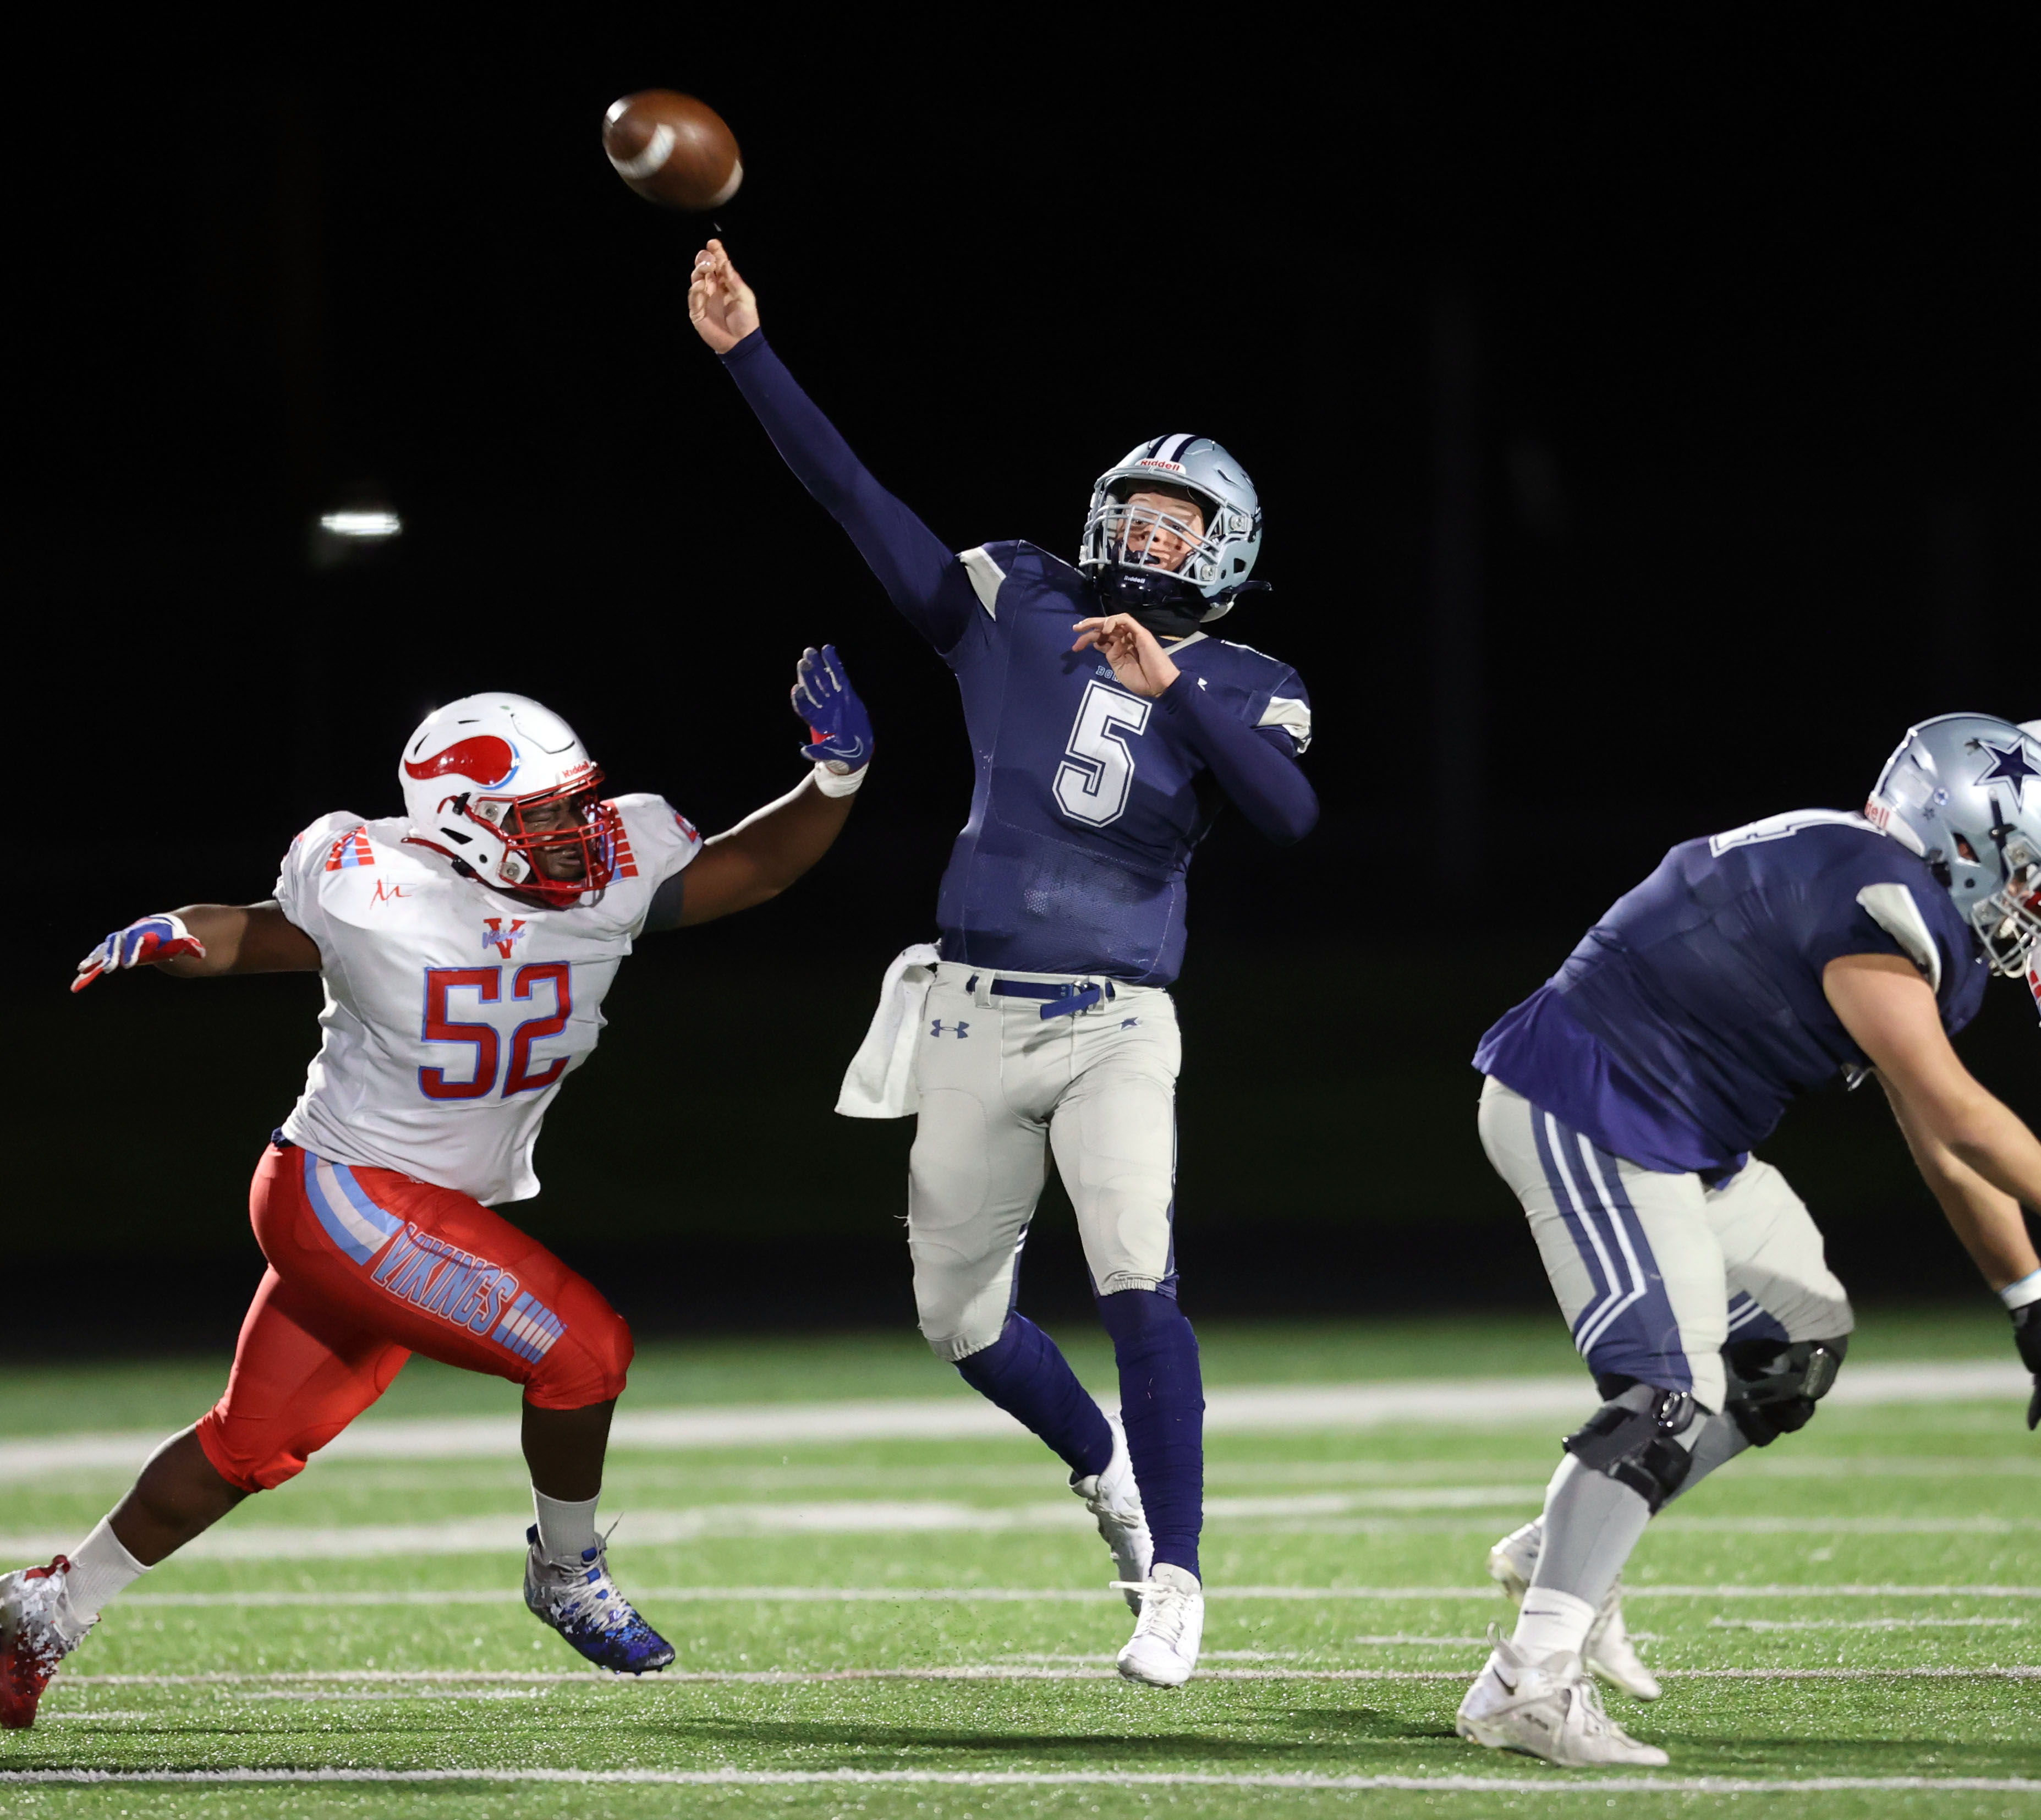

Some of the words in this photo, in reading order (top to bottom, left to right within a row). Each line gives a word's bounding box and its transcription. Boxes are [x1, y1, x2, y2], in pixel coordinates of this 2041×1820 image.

[1140, 460, 1179, 471] Riddell
[1123, 575, 1145, 584] Riddell
[562, 760, 590, 779] Riddell
[1052, 679, 1152, 828] 5
[419, 961, 572, 1100] 52
[370, 1222, 519, 1336] VIKINGS
